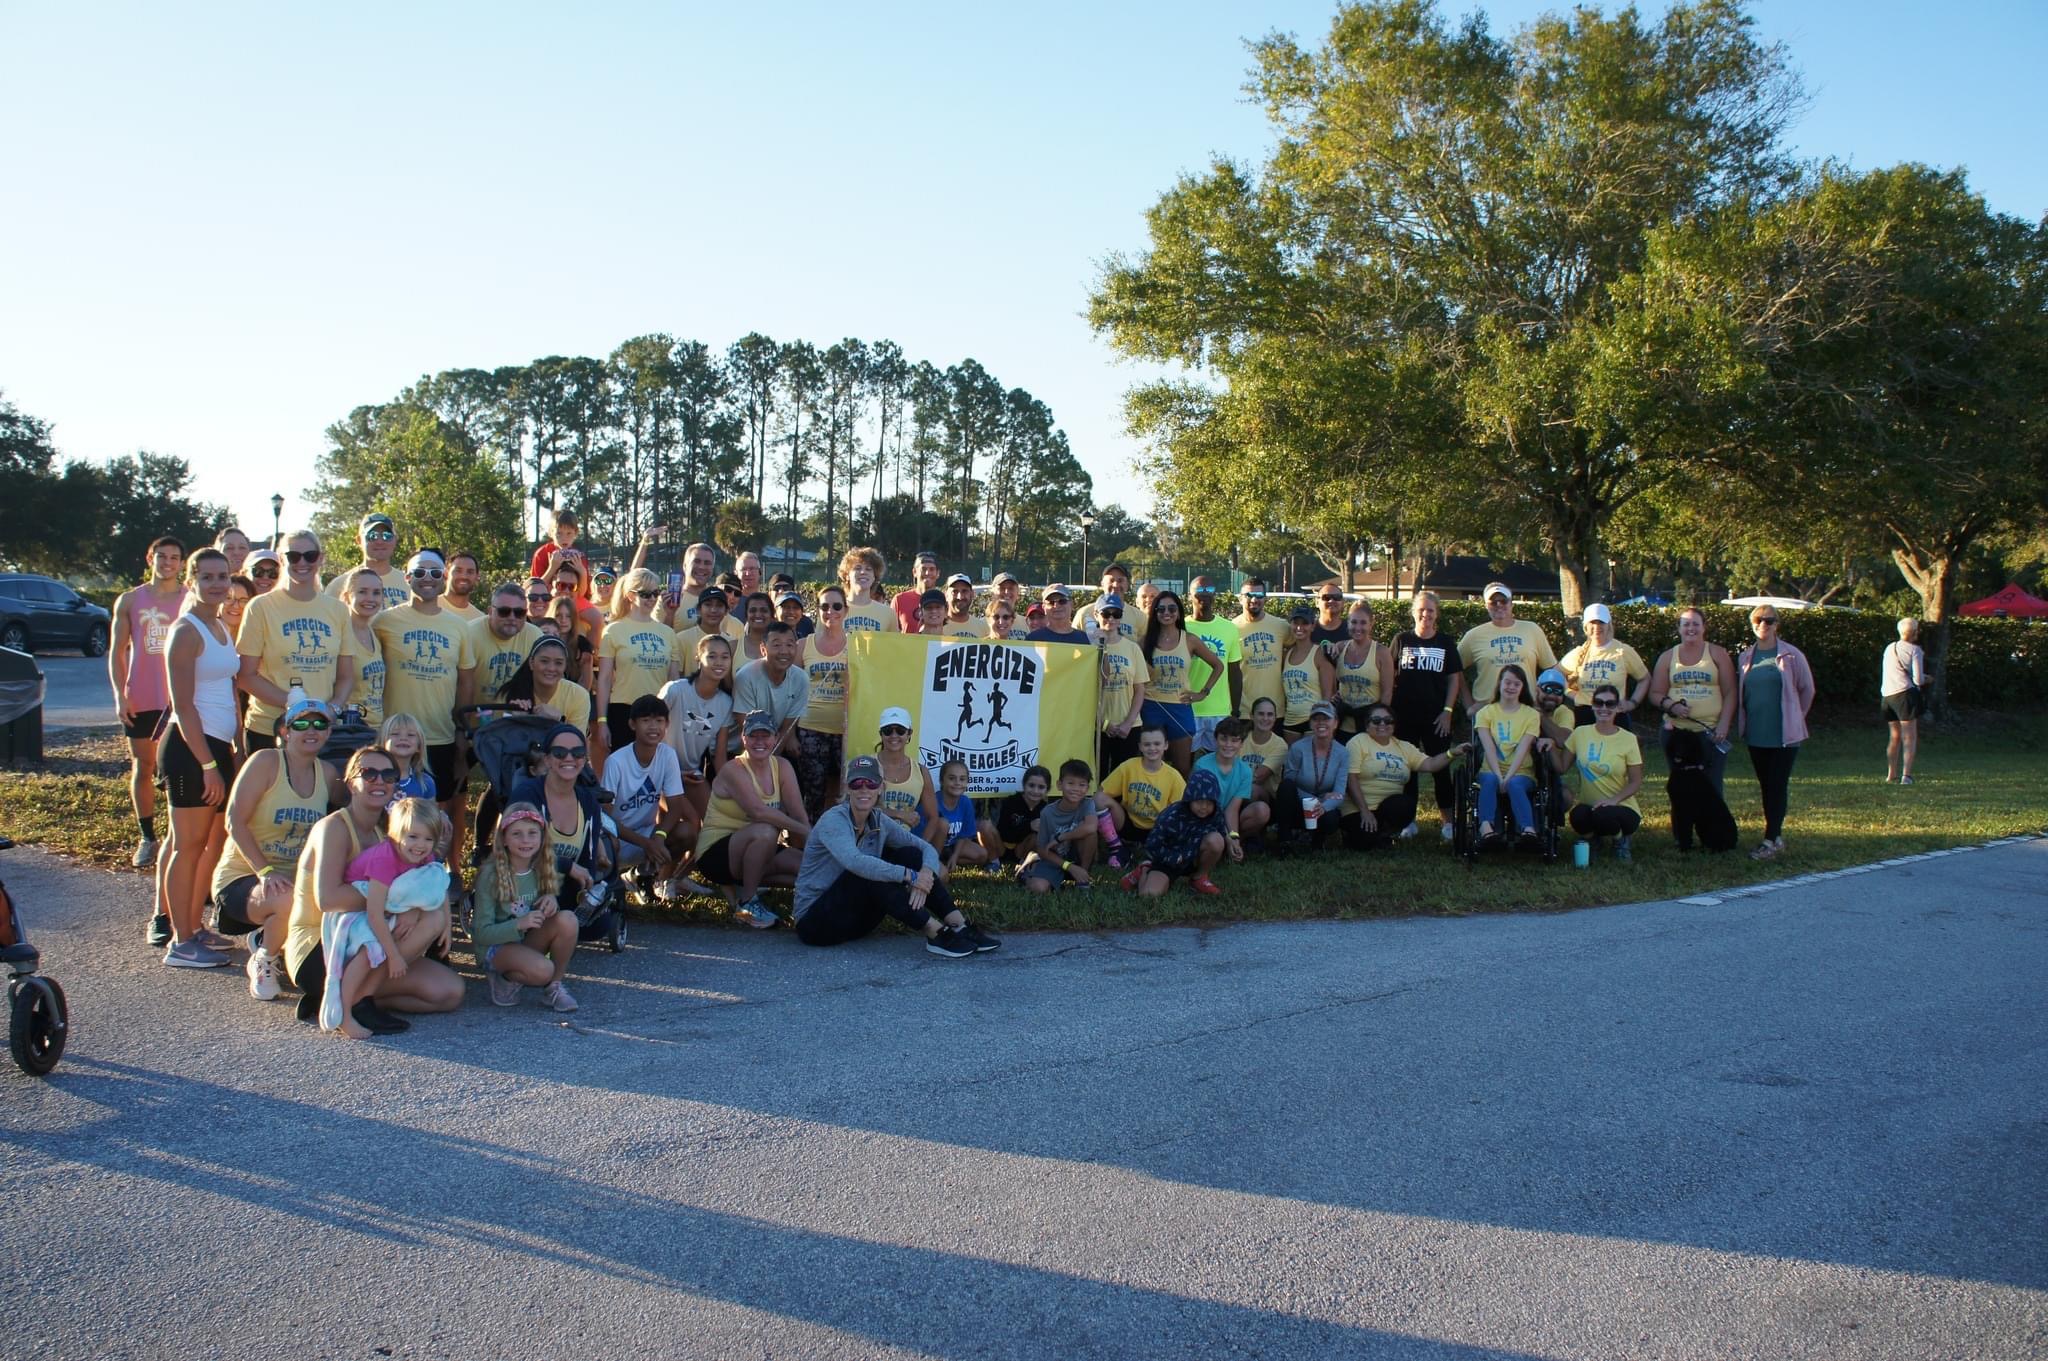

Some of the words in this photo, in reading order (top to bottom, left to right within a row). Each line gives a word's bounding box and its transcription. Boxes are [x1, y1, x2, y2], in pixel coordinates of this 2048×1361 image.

[283, 618, 331, 636] ENERGIZE
[844, 617, 881, 631] ENERGIZE
[403, 629, 449, 648] ENERGIZE
[630, 632, 665, 646] ENERGIZE
[1244, 632, 1275, 647] ENERGIZE
[933, 644, 1036, 694] ENERGIZE
[1401, 656, 1414, 670] BE
[1417, 655, 1444, 672] KIND
[1674, 670, 1711, 683] ENERGIZE
[927, 752, 937, 766] 5
[943, 745, 965, 763] THE
[970, 745, 1016, 769] EAGLES
[1022, 753, 1031, 767] K
[986, 776, 994, 785] 8,
[996, 776, 1017, 784] 2022
[965, 785, 999, 793] atb.org
